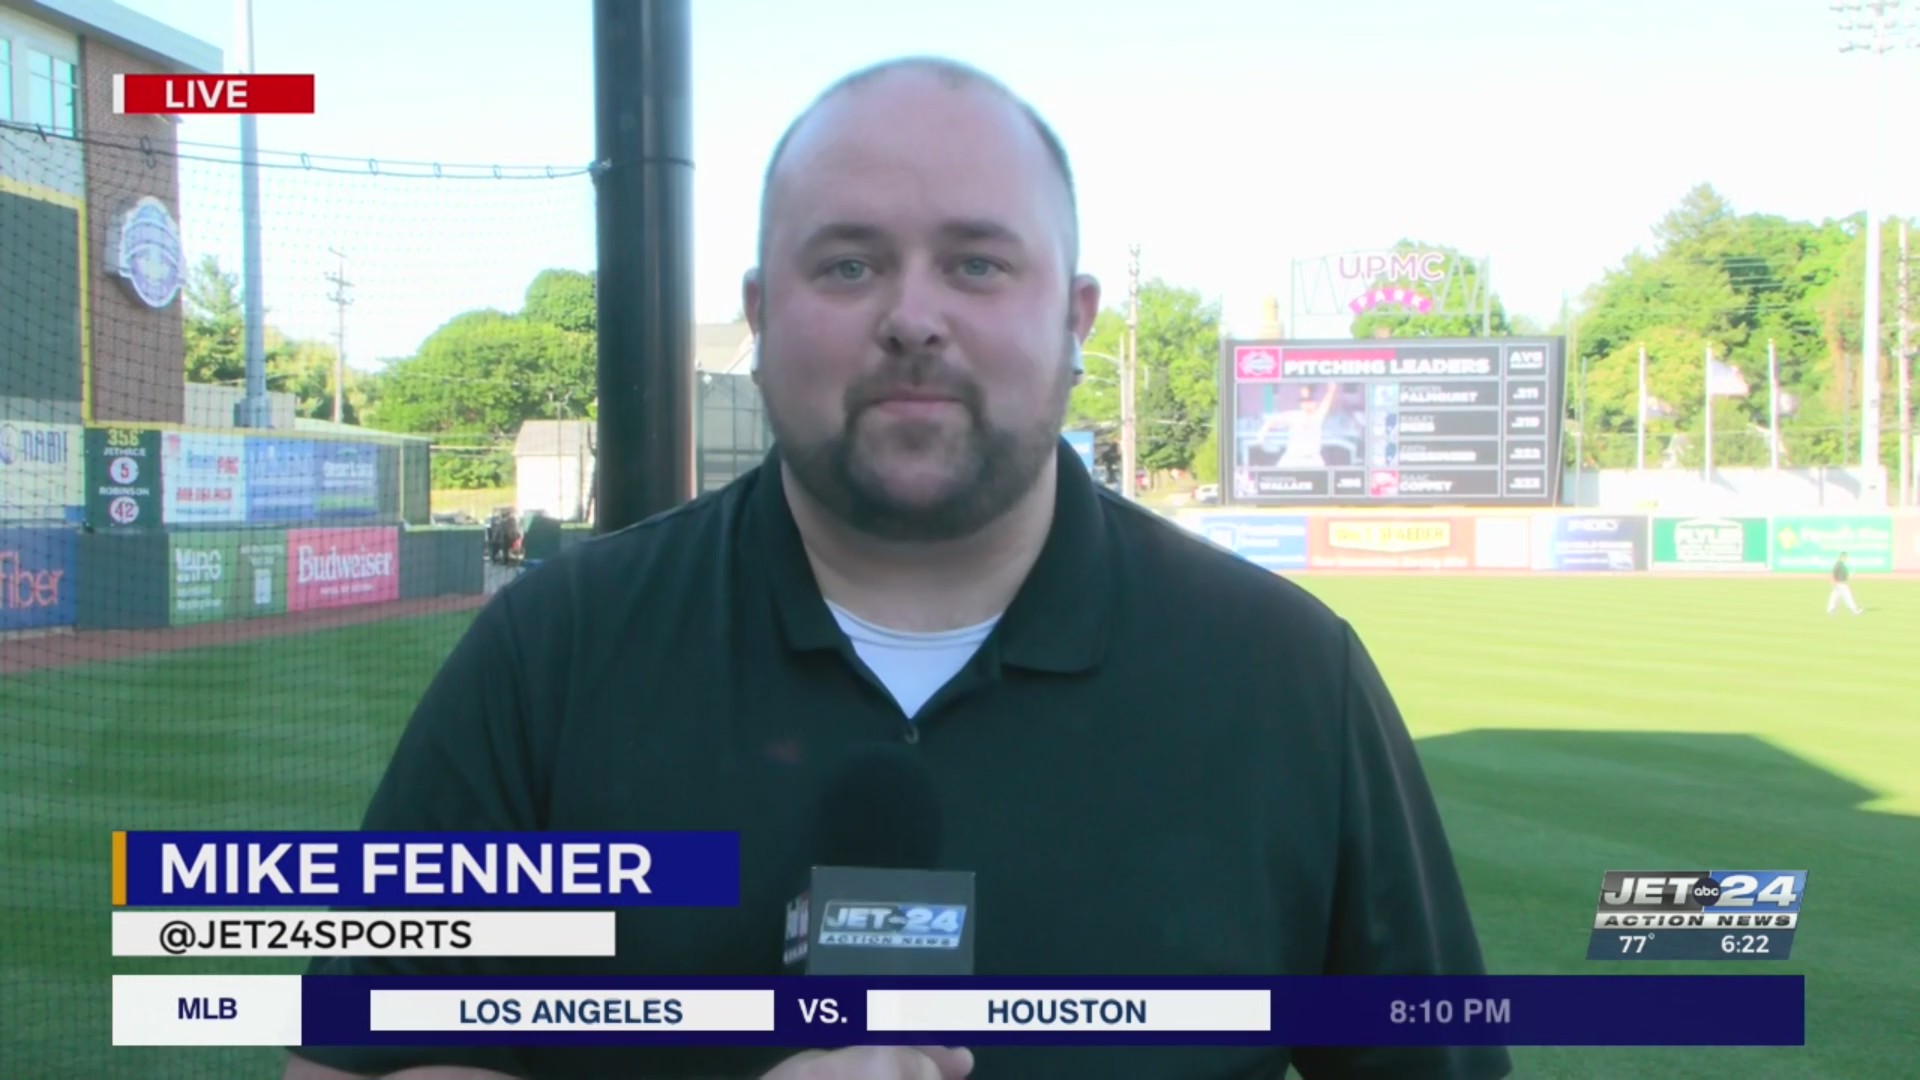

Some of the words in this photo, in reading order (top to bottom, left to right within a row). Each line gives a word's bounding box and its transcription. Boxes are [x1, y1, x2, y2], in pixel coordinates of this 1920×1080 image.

[1338, 253, 1444, 281] UPMC
[1284, 359, 1386, 376] PITCHING
[1390, 358, 1490, 375] LEADERS
[115, 501, 135, 519] 42
[297, 544, 393, 585] Budweiser
[826, 934, 893, 945] ACTION
[901, 936, 952, 946] NEWS
